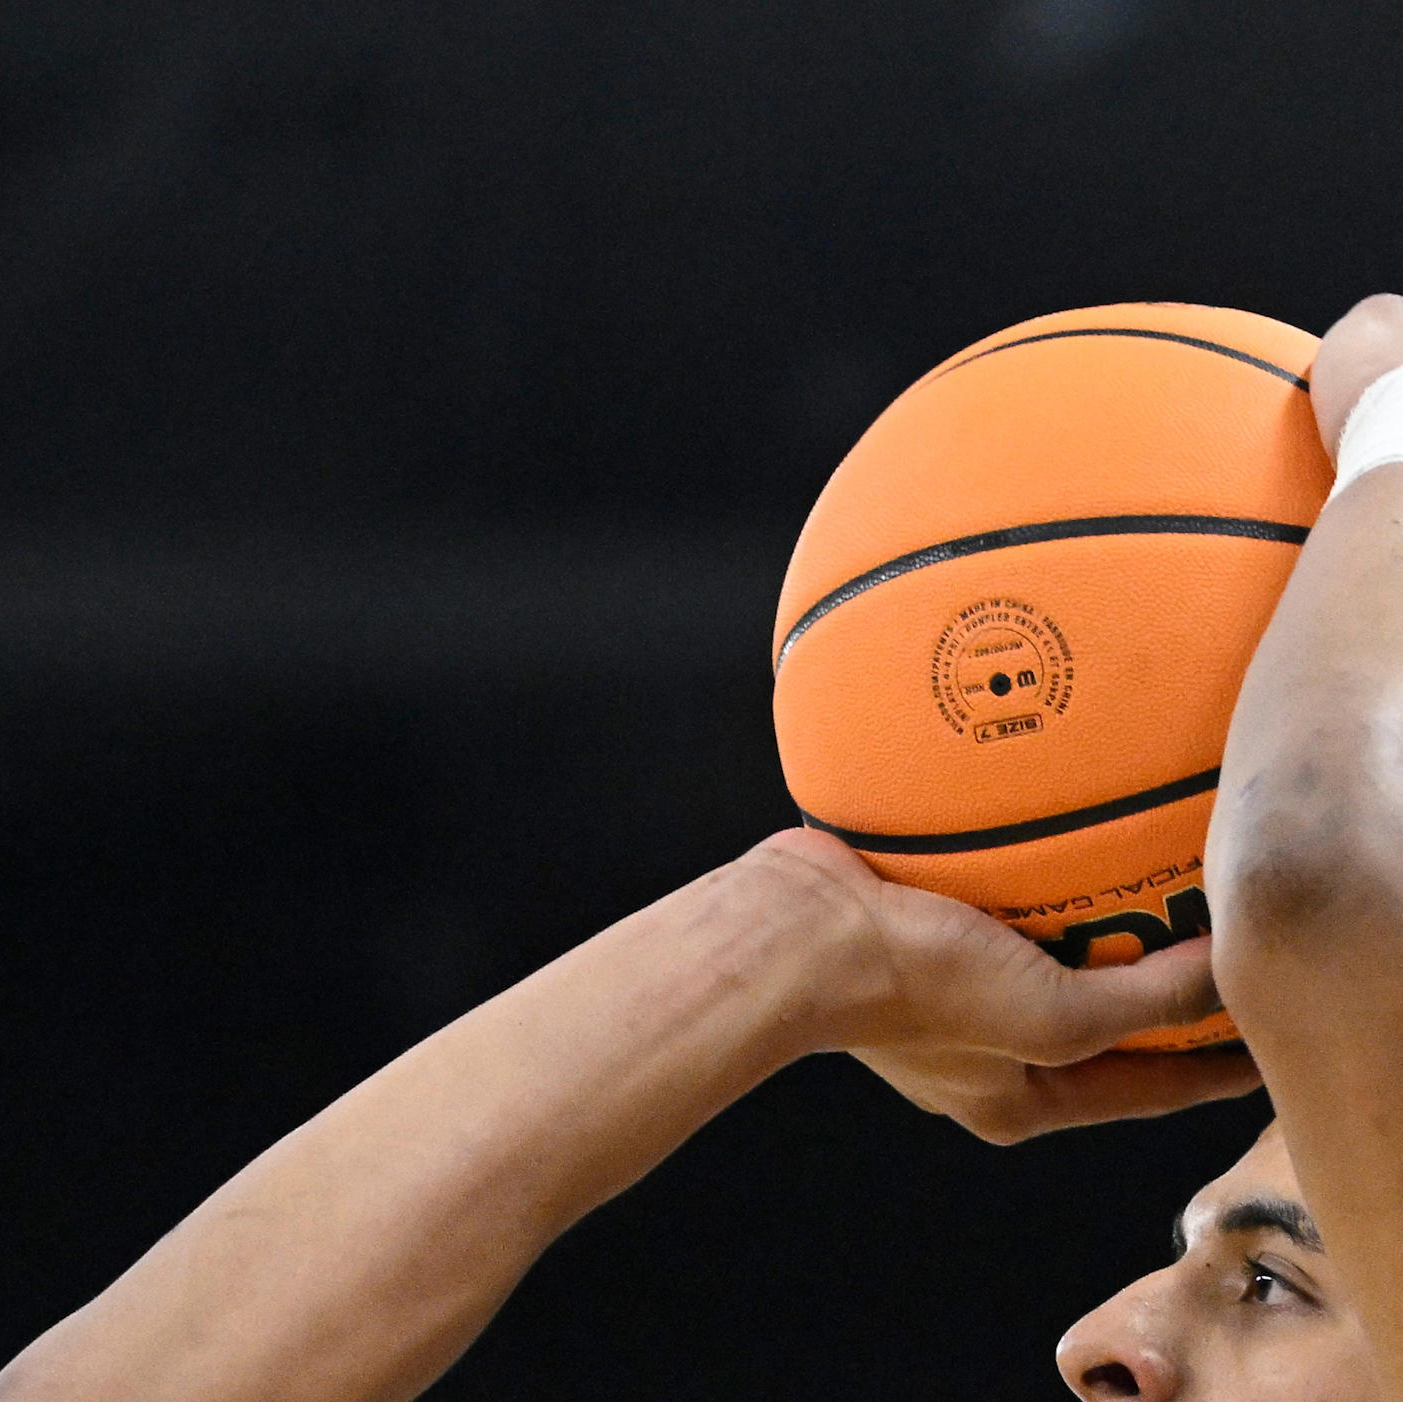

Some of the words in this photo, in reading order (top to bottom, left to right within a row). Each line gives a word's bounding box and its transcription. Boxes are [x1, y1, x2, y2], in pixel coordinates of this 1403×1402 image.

[980, 726, 991, 739] 7
[996, 718, 1037, 735] SIZE
[1100, 856, 1204, 899] FICIAL
[999, 895, 1094, 920] GAME
